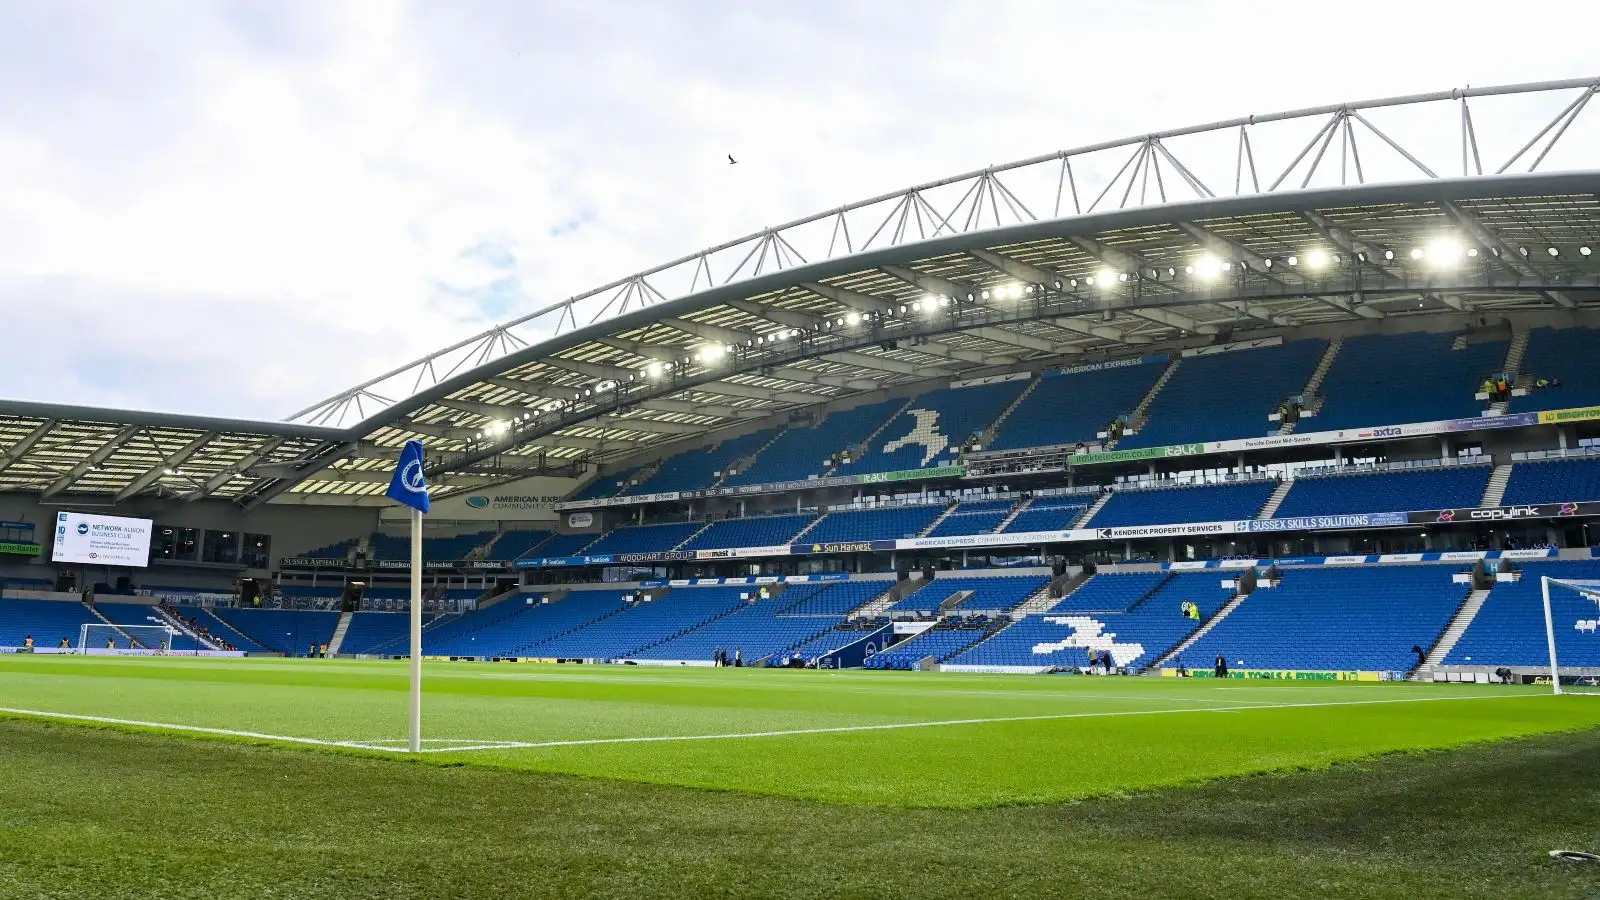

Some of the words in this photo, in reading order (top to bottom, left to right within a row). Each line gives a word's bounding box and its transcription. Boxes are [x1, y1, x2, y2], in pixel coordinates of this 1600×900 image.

[1060, 363, 1102, 375] AMERICAN
[1104, 357, 1143, 369] EXPRESS
[1373, 427, 1402, 437] axtra
[1470, 506, 1540, 520] copylink
[92, 524, 122, 532] NETWORK
[1252, 519, 1285, 531] SUSSEX
[1287, 517, 1317, 529] SKILLS
[1318, 515, 1369, 528] SOLUTIONS
[1113, 528, 1148, 536] KENDRICK
[1149, 526, 1186, 534] PROPERTY
[1187, 524, 1223, 533] SERVICES
[824, 543, 839, 552] Sun
[840, 541, 872, 552] Harvest
[947, 537, 976, 545] EXPRESS
[620, 553, 661, 562] WOODHART
[664, 551, 694, 560] GROUP
[379, 560, 411, 568] Heineken
[1490, 563, 1498, 572] H
